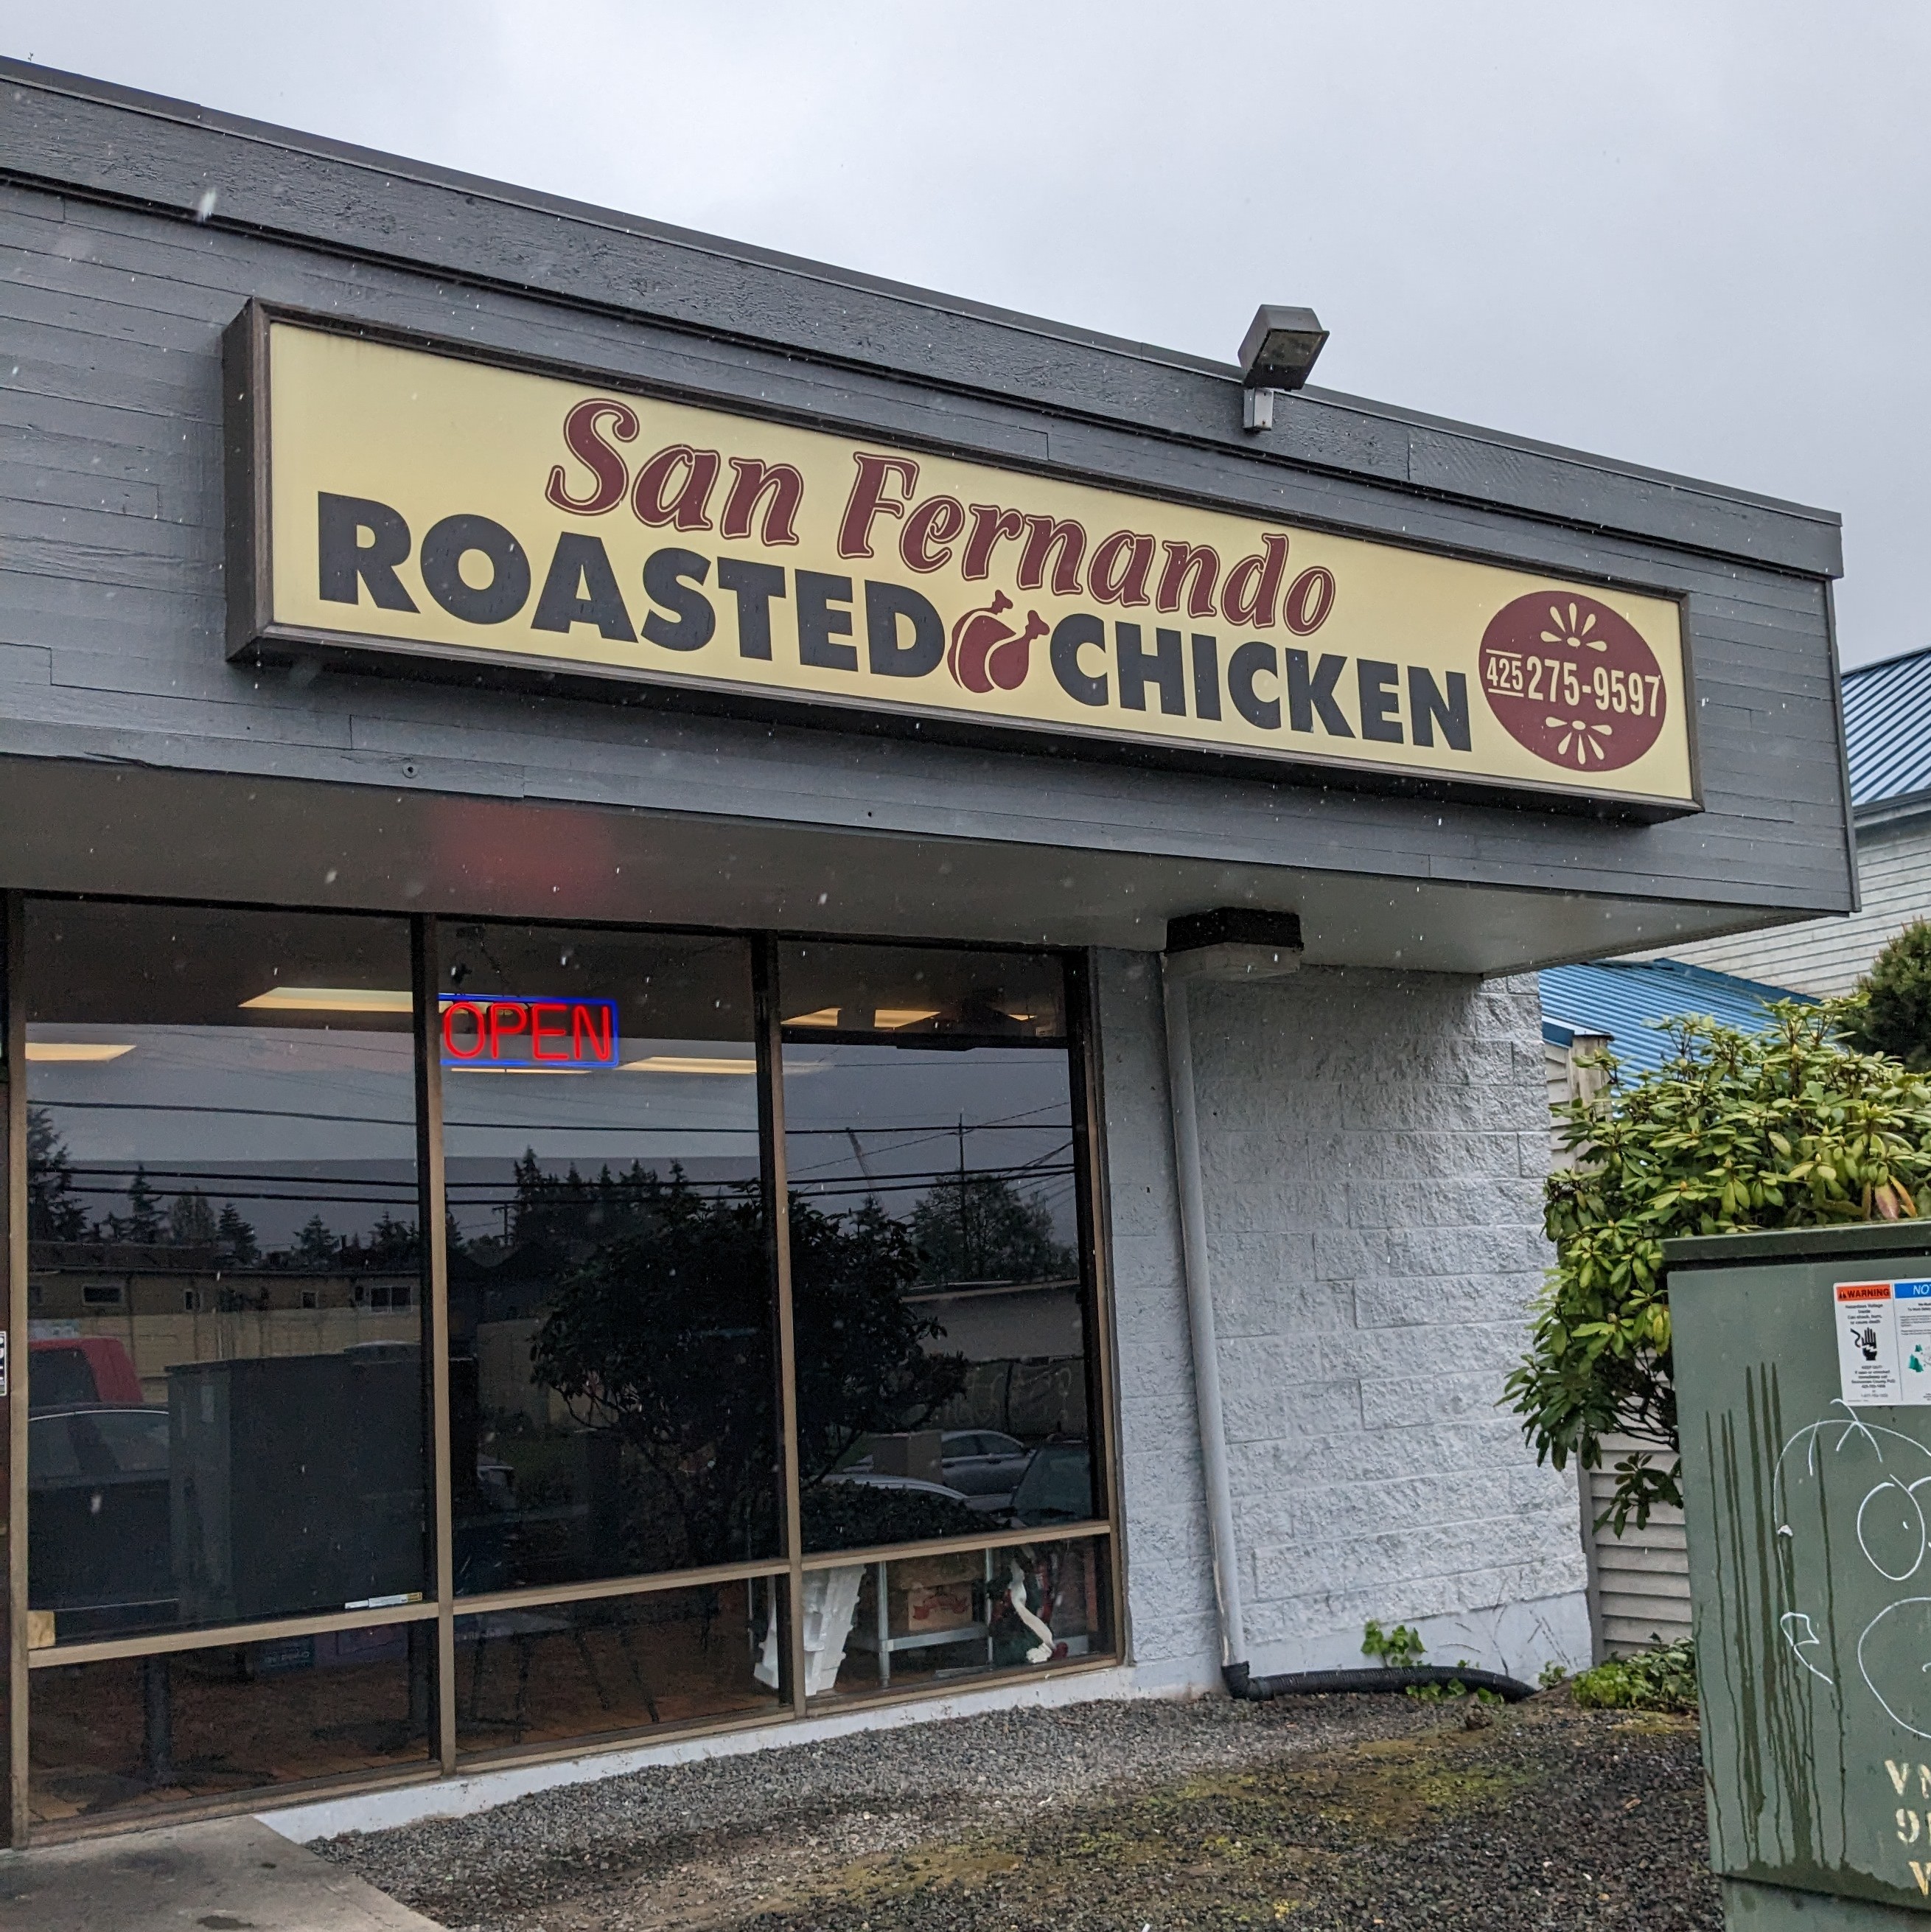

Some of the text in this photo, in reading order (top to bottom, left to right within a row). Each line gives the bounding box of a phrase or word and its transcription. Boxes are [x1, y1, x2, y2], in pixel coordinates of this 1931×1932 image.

[545, 398, 1336, 637] San Fernando
[318, 491, 1473, 753] ROASTED CHICKEN
[1487, 656, 1661, 717] 425 275-9597
[444, 1002, 612, 1060] OPEN
[1847, 1288, 1890, 1298] WARNING
